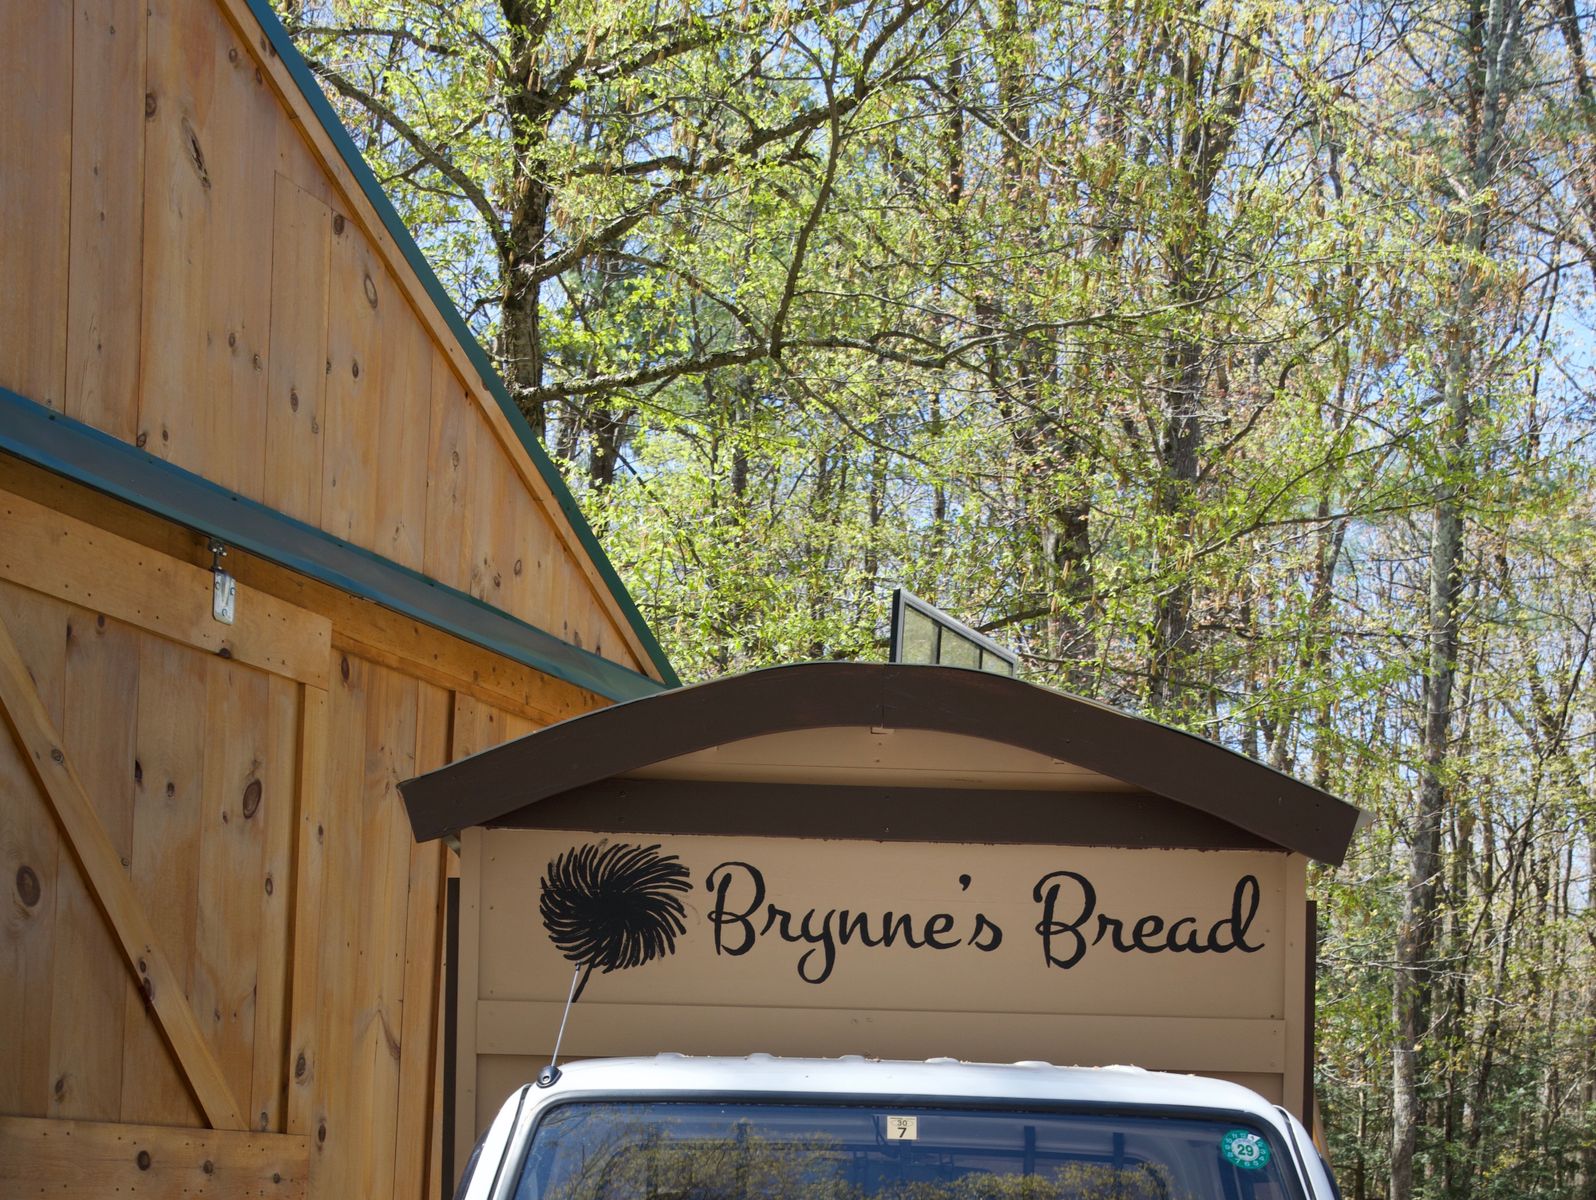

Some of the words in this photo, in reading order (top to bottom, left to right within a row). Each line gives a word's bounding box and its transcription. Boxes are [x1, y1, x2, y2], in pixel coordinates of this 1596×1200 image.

[705, 861, 1003, 985] Brynne's
[1032, 870, 1266, 970] Bread
[897, 1127, 907, 1138] 7
[1237, 1143, 1254, 1157] 29
